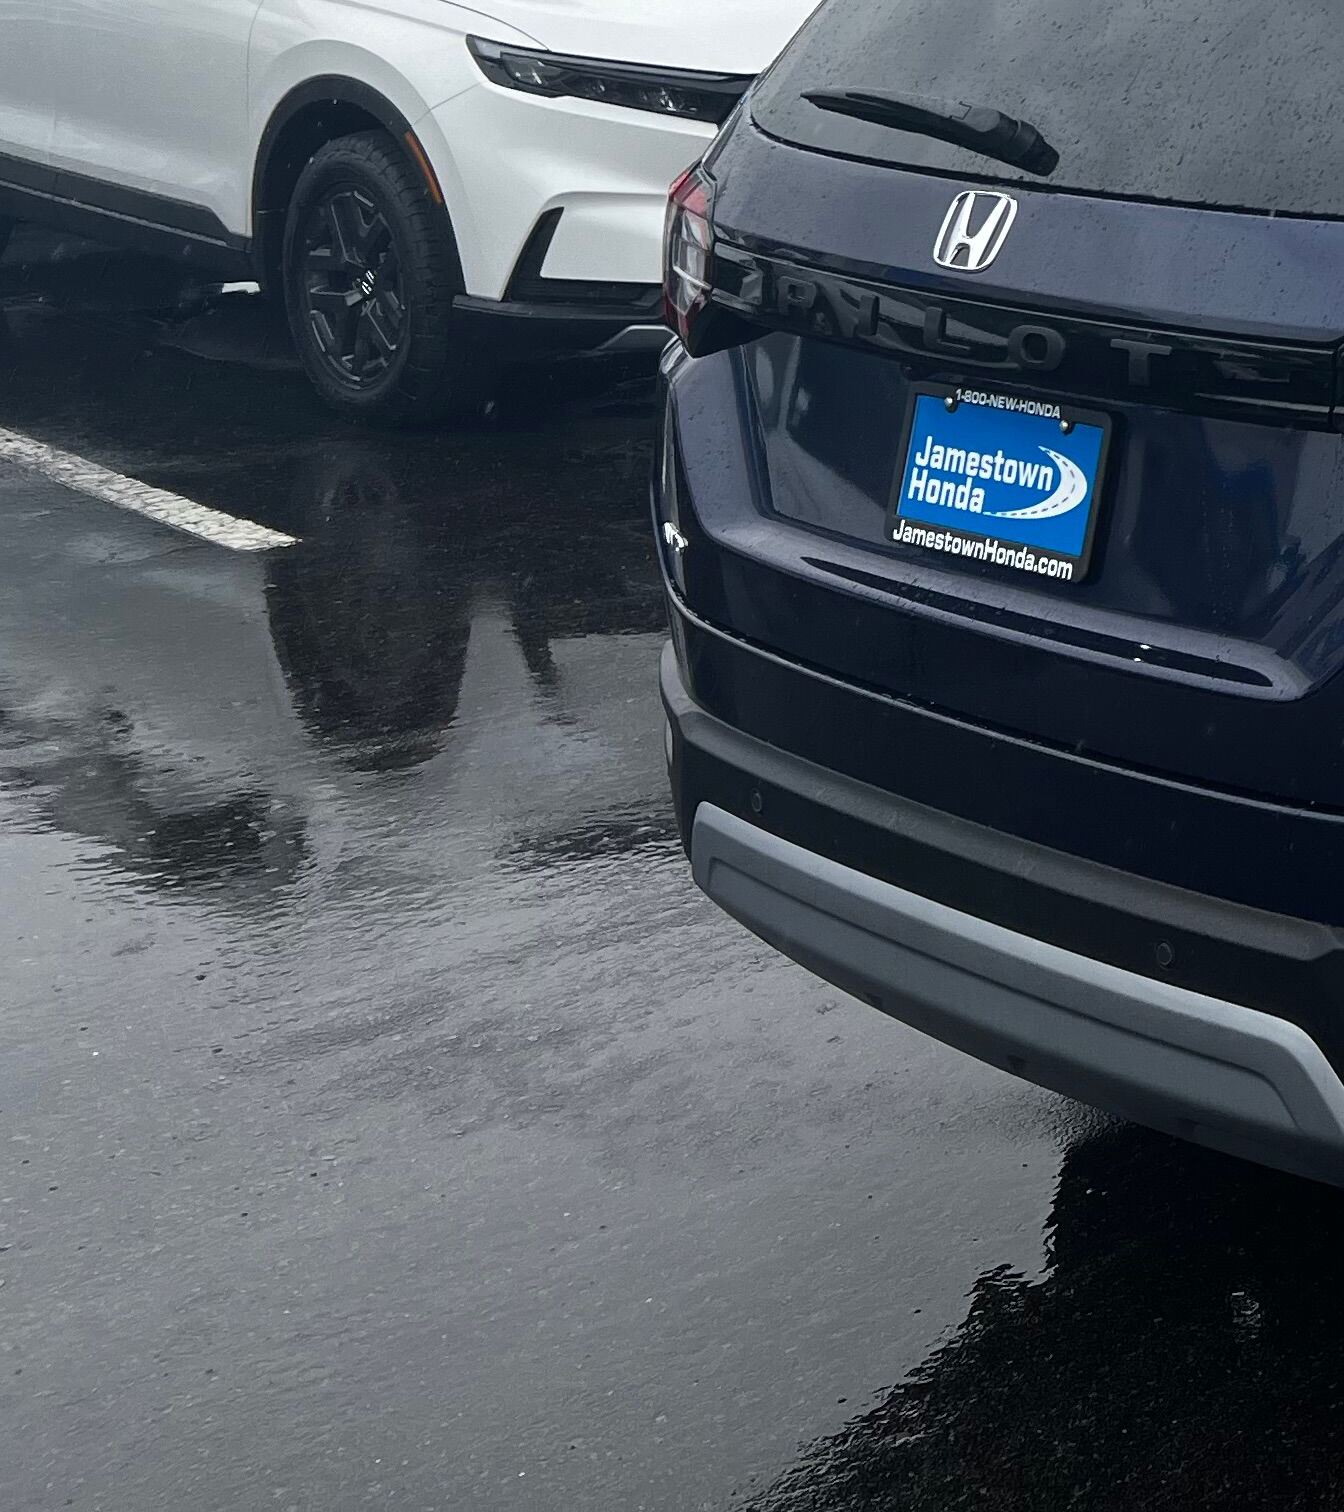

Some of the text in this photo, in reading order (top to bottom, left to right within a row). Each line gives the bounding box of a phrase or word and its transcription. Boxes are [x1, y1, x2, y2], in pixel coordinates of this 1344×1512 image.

[777, 275, 1173, 386] PILOT
[955, 388, 1062, 419] 1-800-NEW-HONDA
[907, 467, 986, 514] Honda
[914, 435, 1055, 492] Jamestown
[892, 519, 1074, 581] JamestownHonda.com
